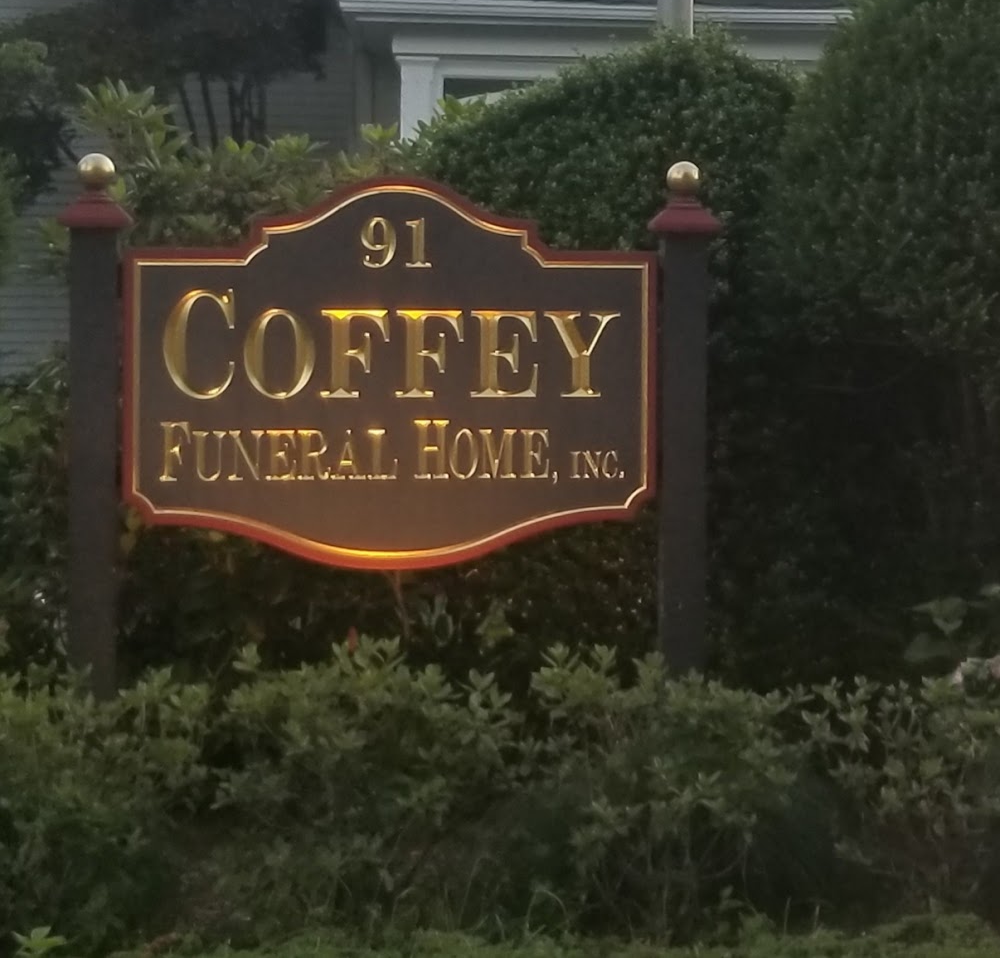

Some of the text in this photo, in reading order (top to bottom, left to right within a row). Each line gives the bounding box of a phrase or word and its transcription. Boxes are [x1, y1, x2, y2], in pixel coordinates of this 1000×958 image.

[360, 216, 433, 269] 91
[162, 288, 622, 400] COFFEY
[158, 418, 626, 485] FUNERAL HOME, INC.
